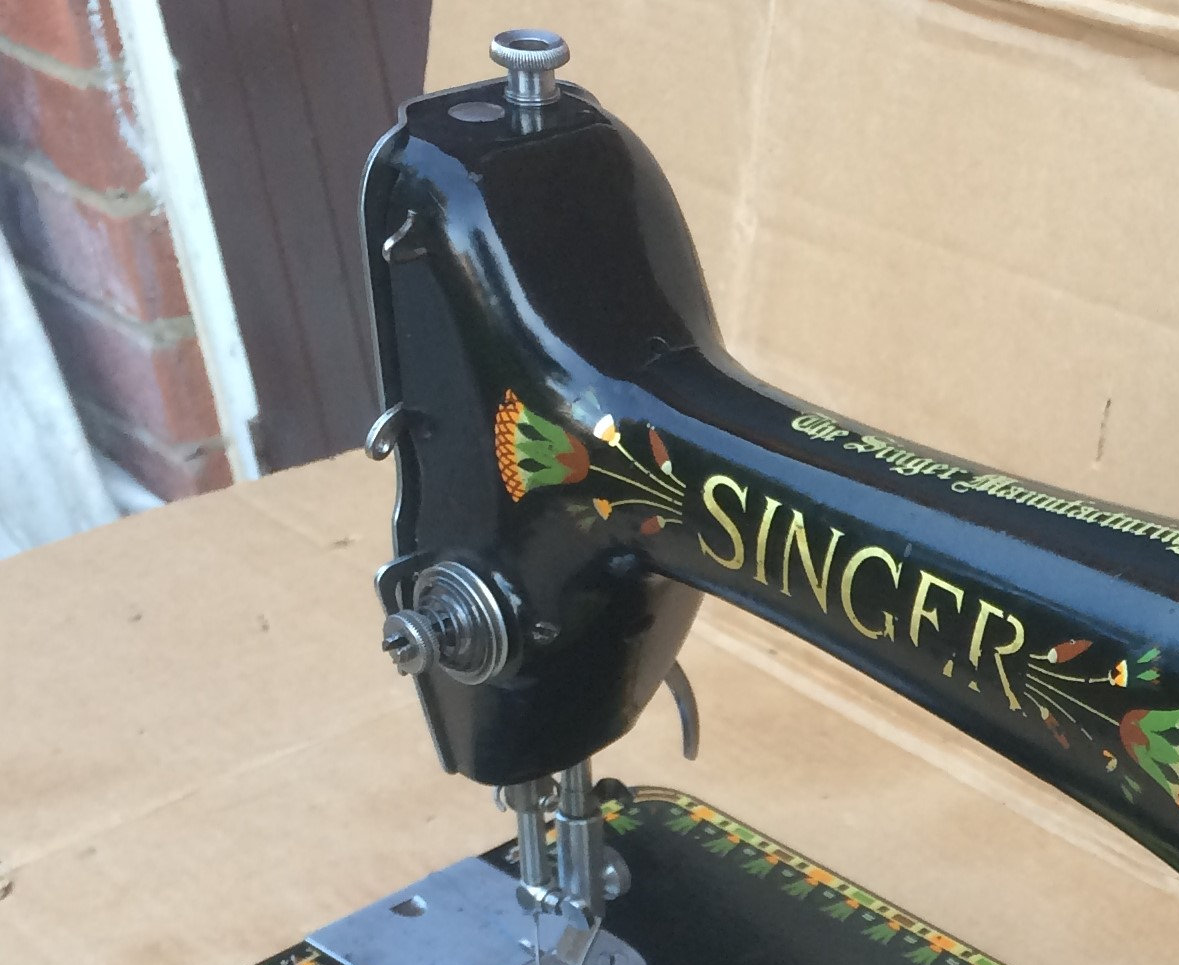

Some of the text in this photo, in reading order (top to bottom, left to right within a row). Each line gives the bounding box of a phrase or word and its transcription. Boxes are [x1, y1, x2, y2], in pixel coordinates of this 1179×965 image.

[791, 412, 849, 442] The
[843, 435, 967, 480] Singer
[698, 475, 1025, 717] SINGER
